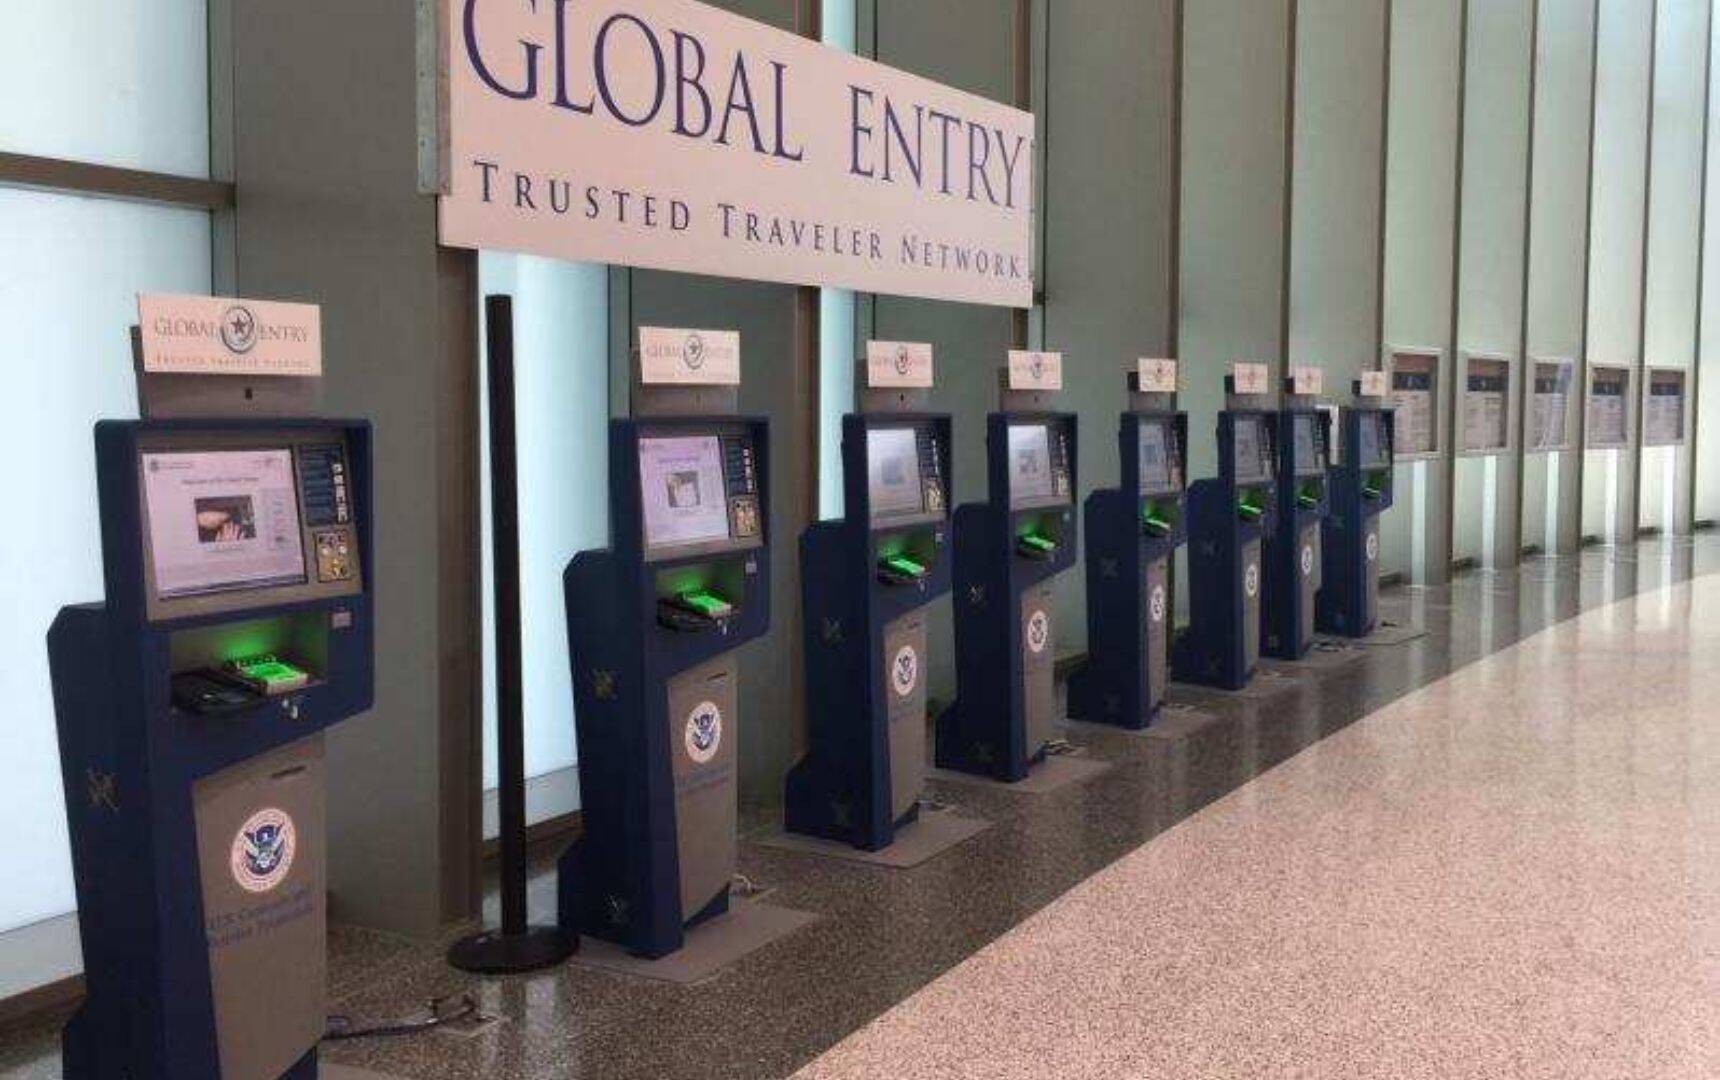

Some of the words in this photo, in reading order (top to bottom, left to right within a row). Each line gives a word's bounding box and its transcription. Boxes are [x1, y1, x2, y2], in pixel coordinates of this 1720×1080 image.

[463, 0, 803, 161] GLOBAL
[848, 84, 1024, 208] ENTRY
[474, 160, 690, 231] TRUSTED
[717, 203, 883, 258] TRAVELER
[902, 235, 1021, 278] NETWORK
[154, 316, 219, 340] GLOBAL
[259, 322, 308, 343] ENTRY
